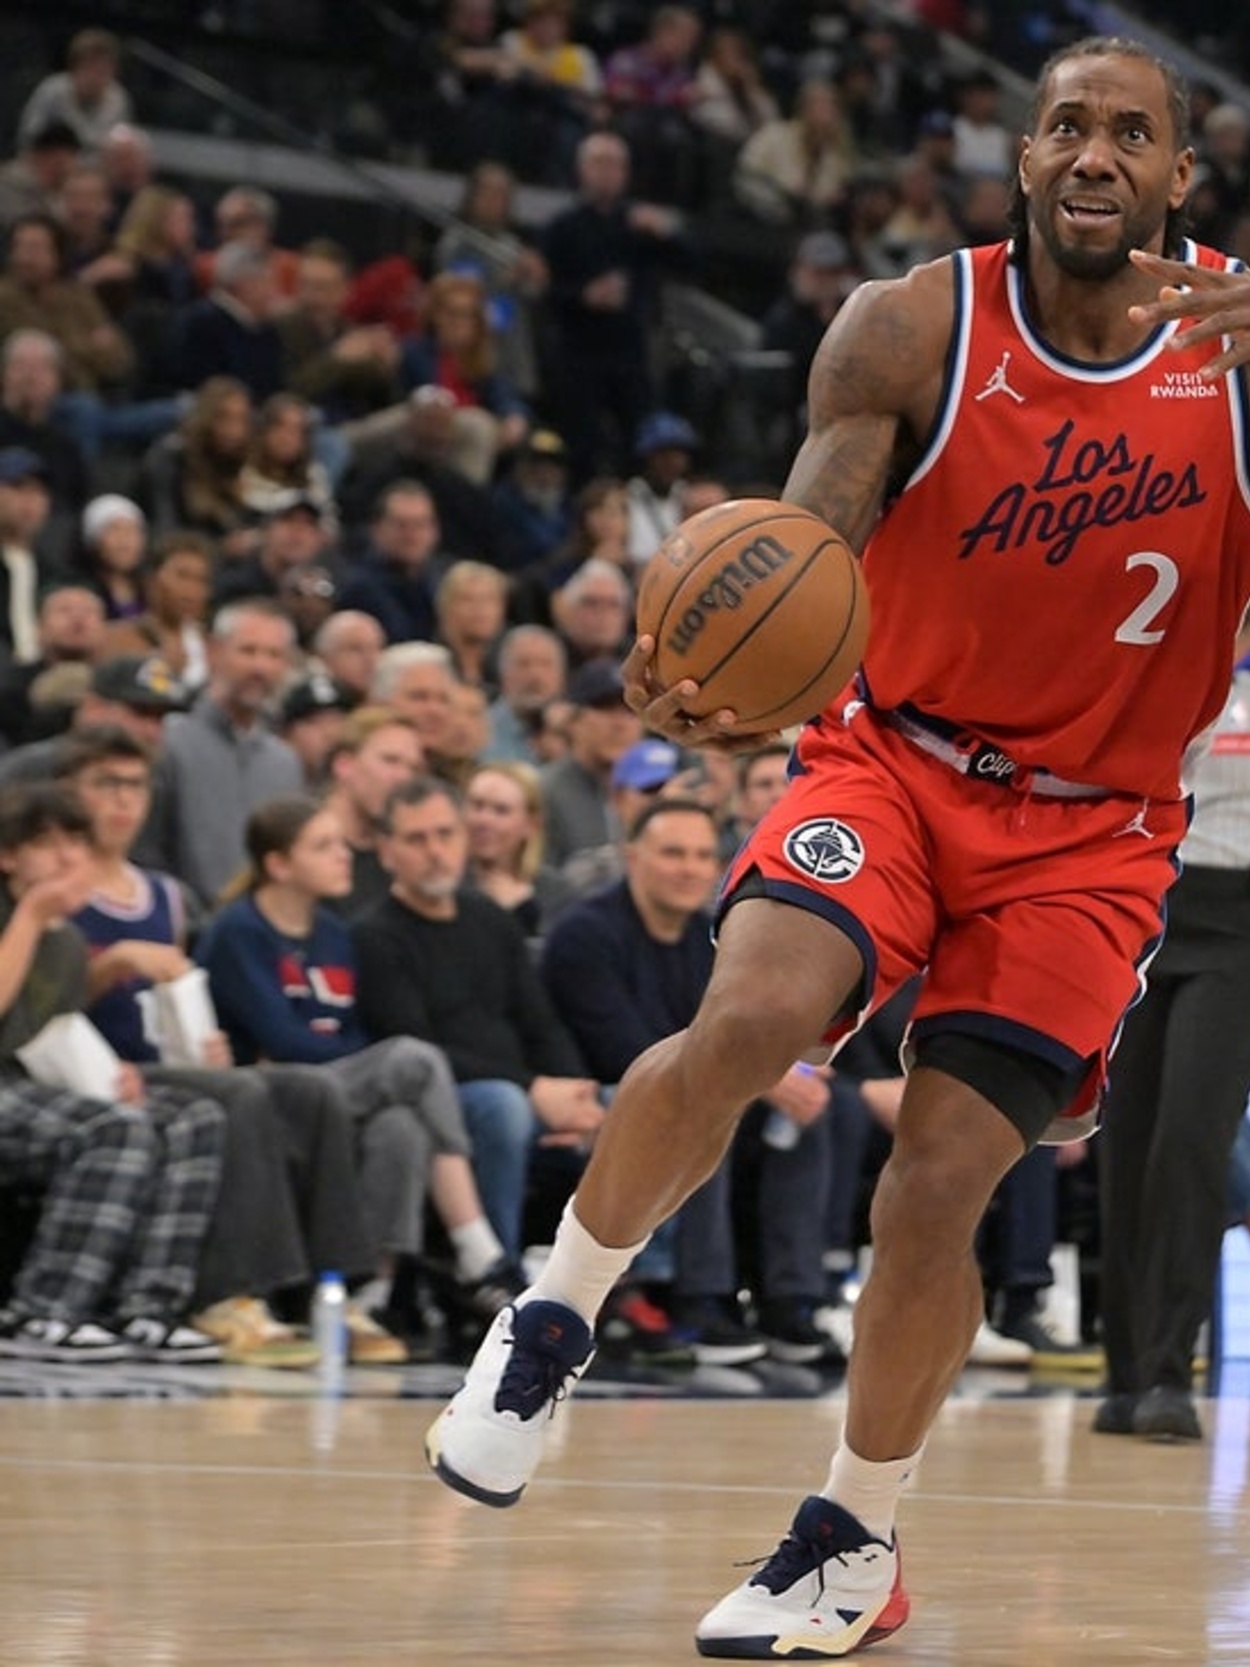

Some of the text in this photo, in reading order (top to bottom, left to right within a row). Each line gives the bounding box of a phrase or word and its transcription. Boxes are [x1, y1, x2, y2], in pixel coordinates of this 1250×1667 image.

[1150, 384, 1219, 398] RWANDA
[1164, 372, 1202, 385] VISIT
[1033, 419, 1137, 493] Los
[957, 455, 1207, 567] Angeles
[1114, 551, 1180, 645] 2
